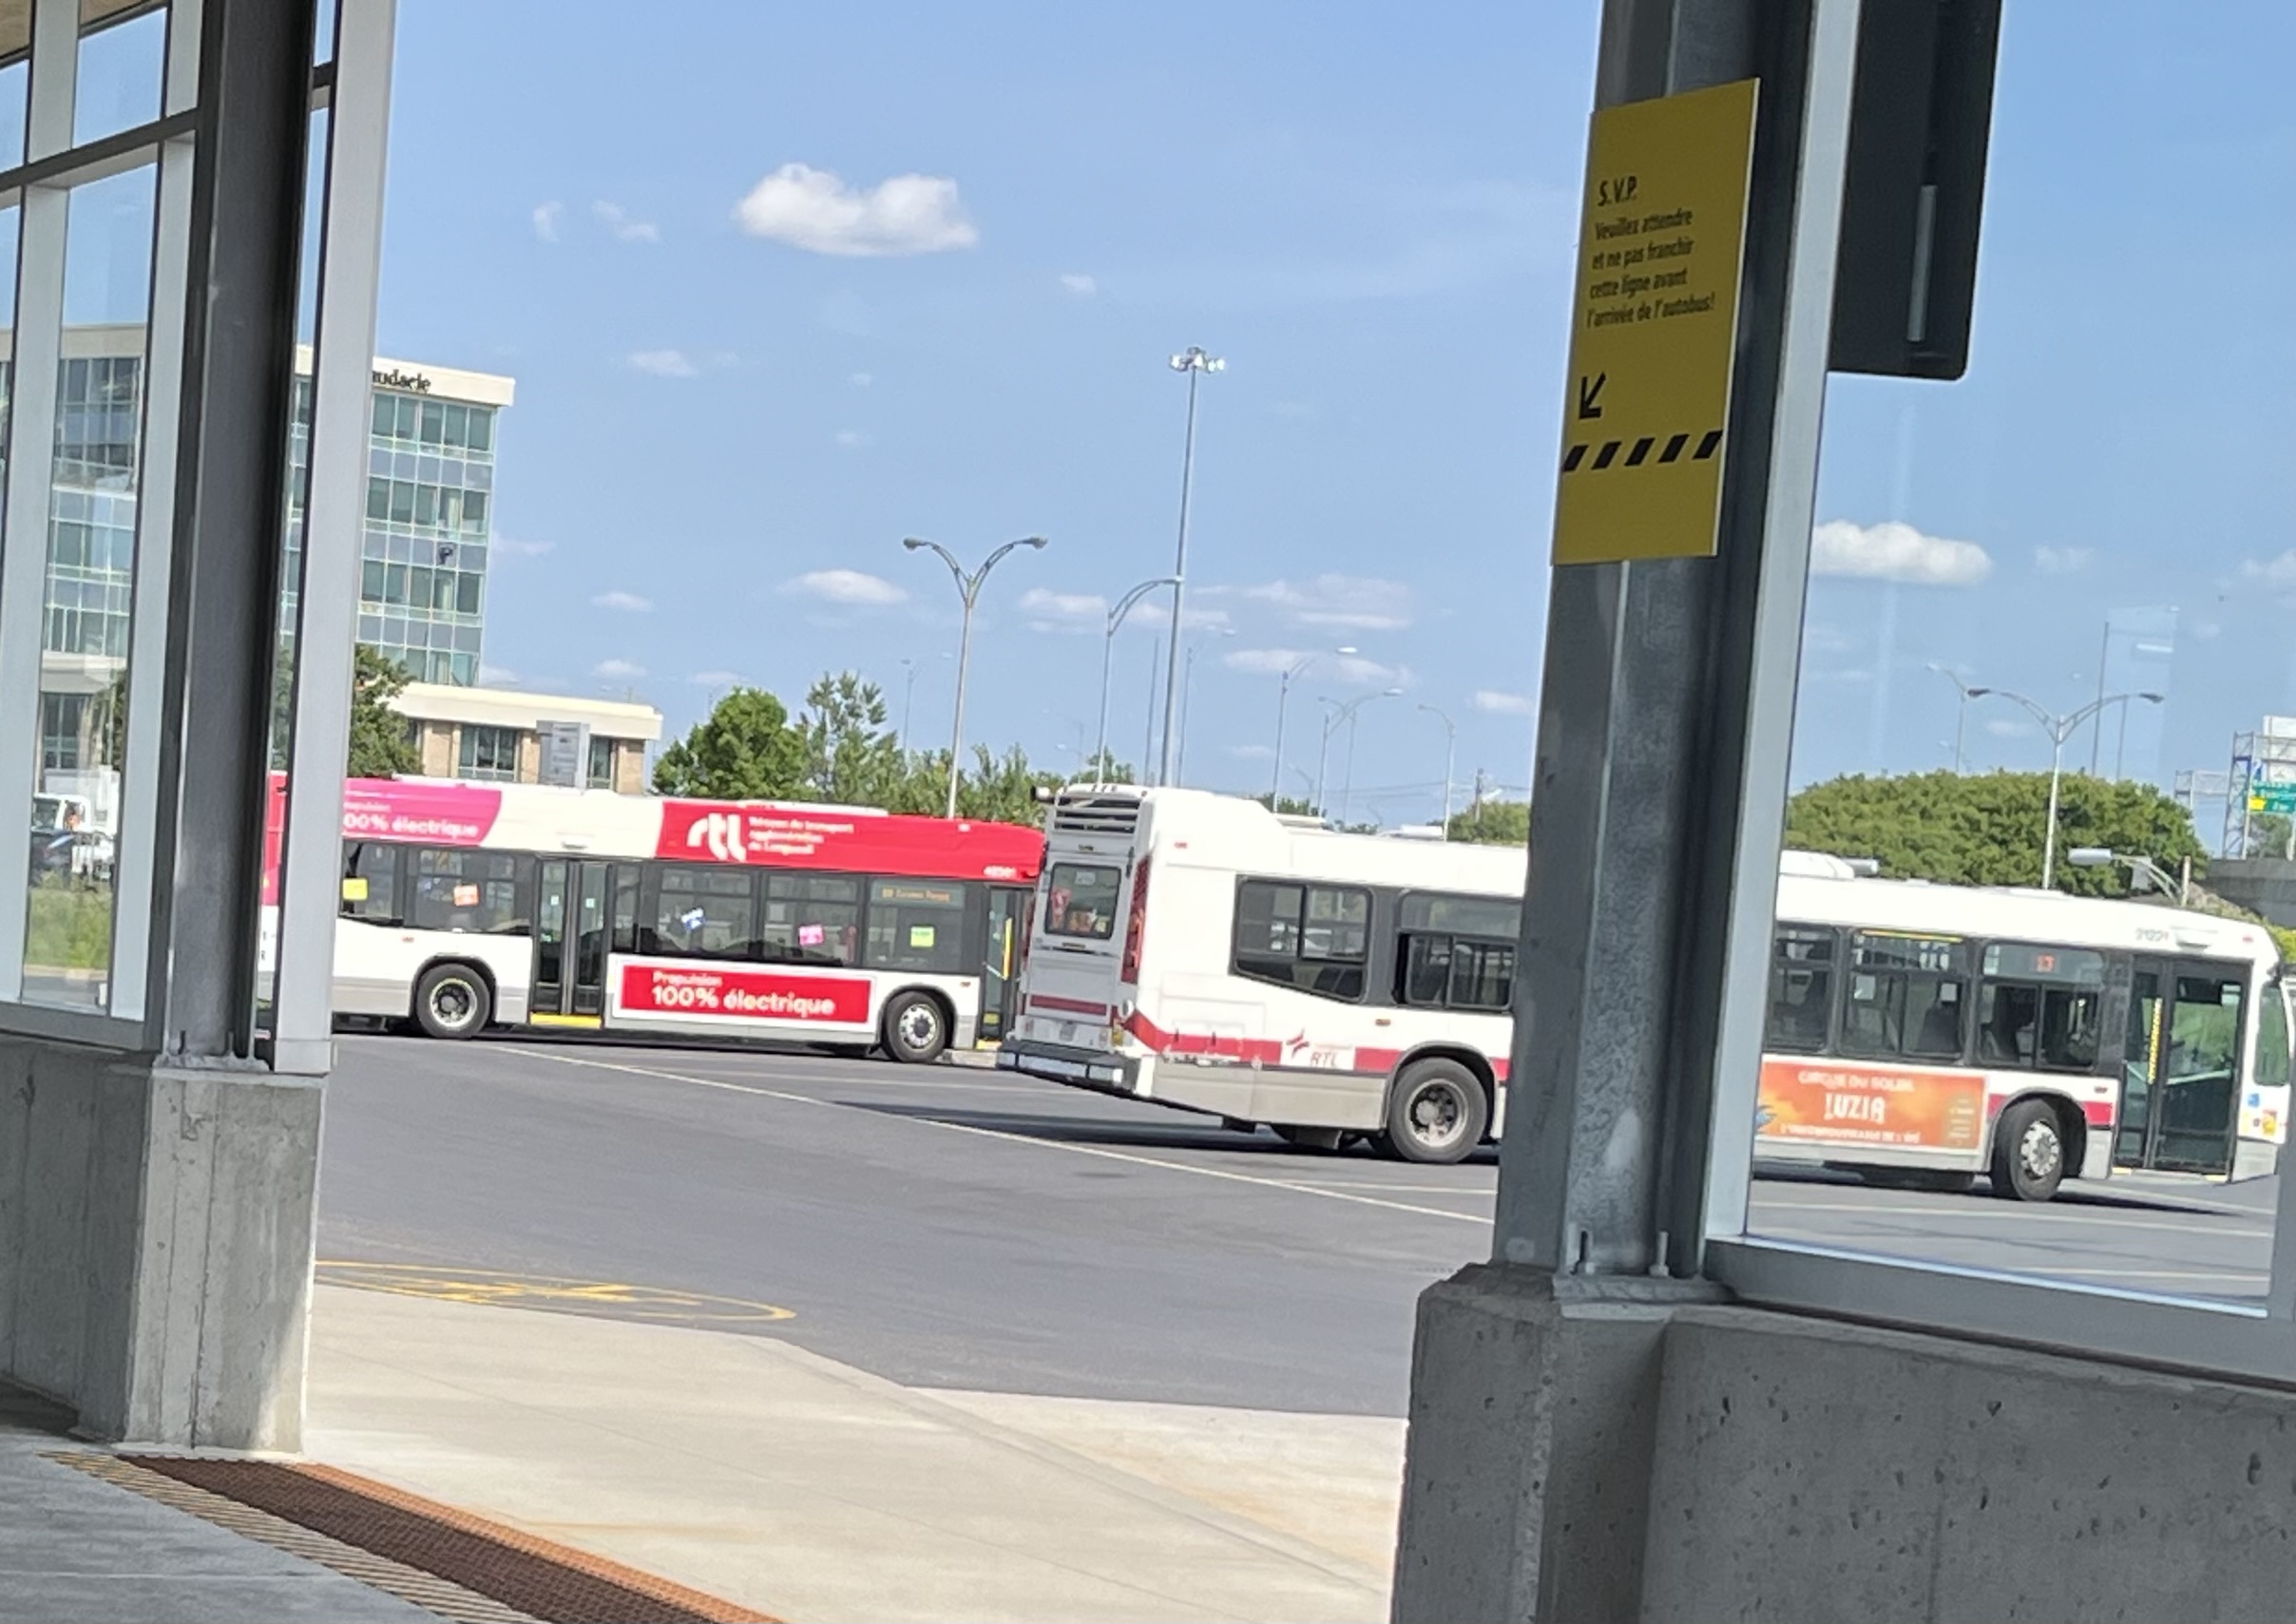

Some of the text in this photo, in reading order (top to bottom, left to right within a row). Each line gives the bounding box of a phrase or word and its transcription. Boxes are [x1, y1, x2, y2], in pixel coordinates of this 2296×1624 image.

[1596, 207, 1693, 239] Veuillez attendre
[1593, 237, 1694, 270] et ne pas franchir
[1590, 267, 1688, 299] cette ligne avant
[1587, 302, 1634, 329] l'arrivée
[1636, 301, 1652, 321] de
[343, 812, 389, 831] 00%
[651, 984, 835, 1019] 100% électrique
[1824, 1093, 1886, 1125] LUZIA
